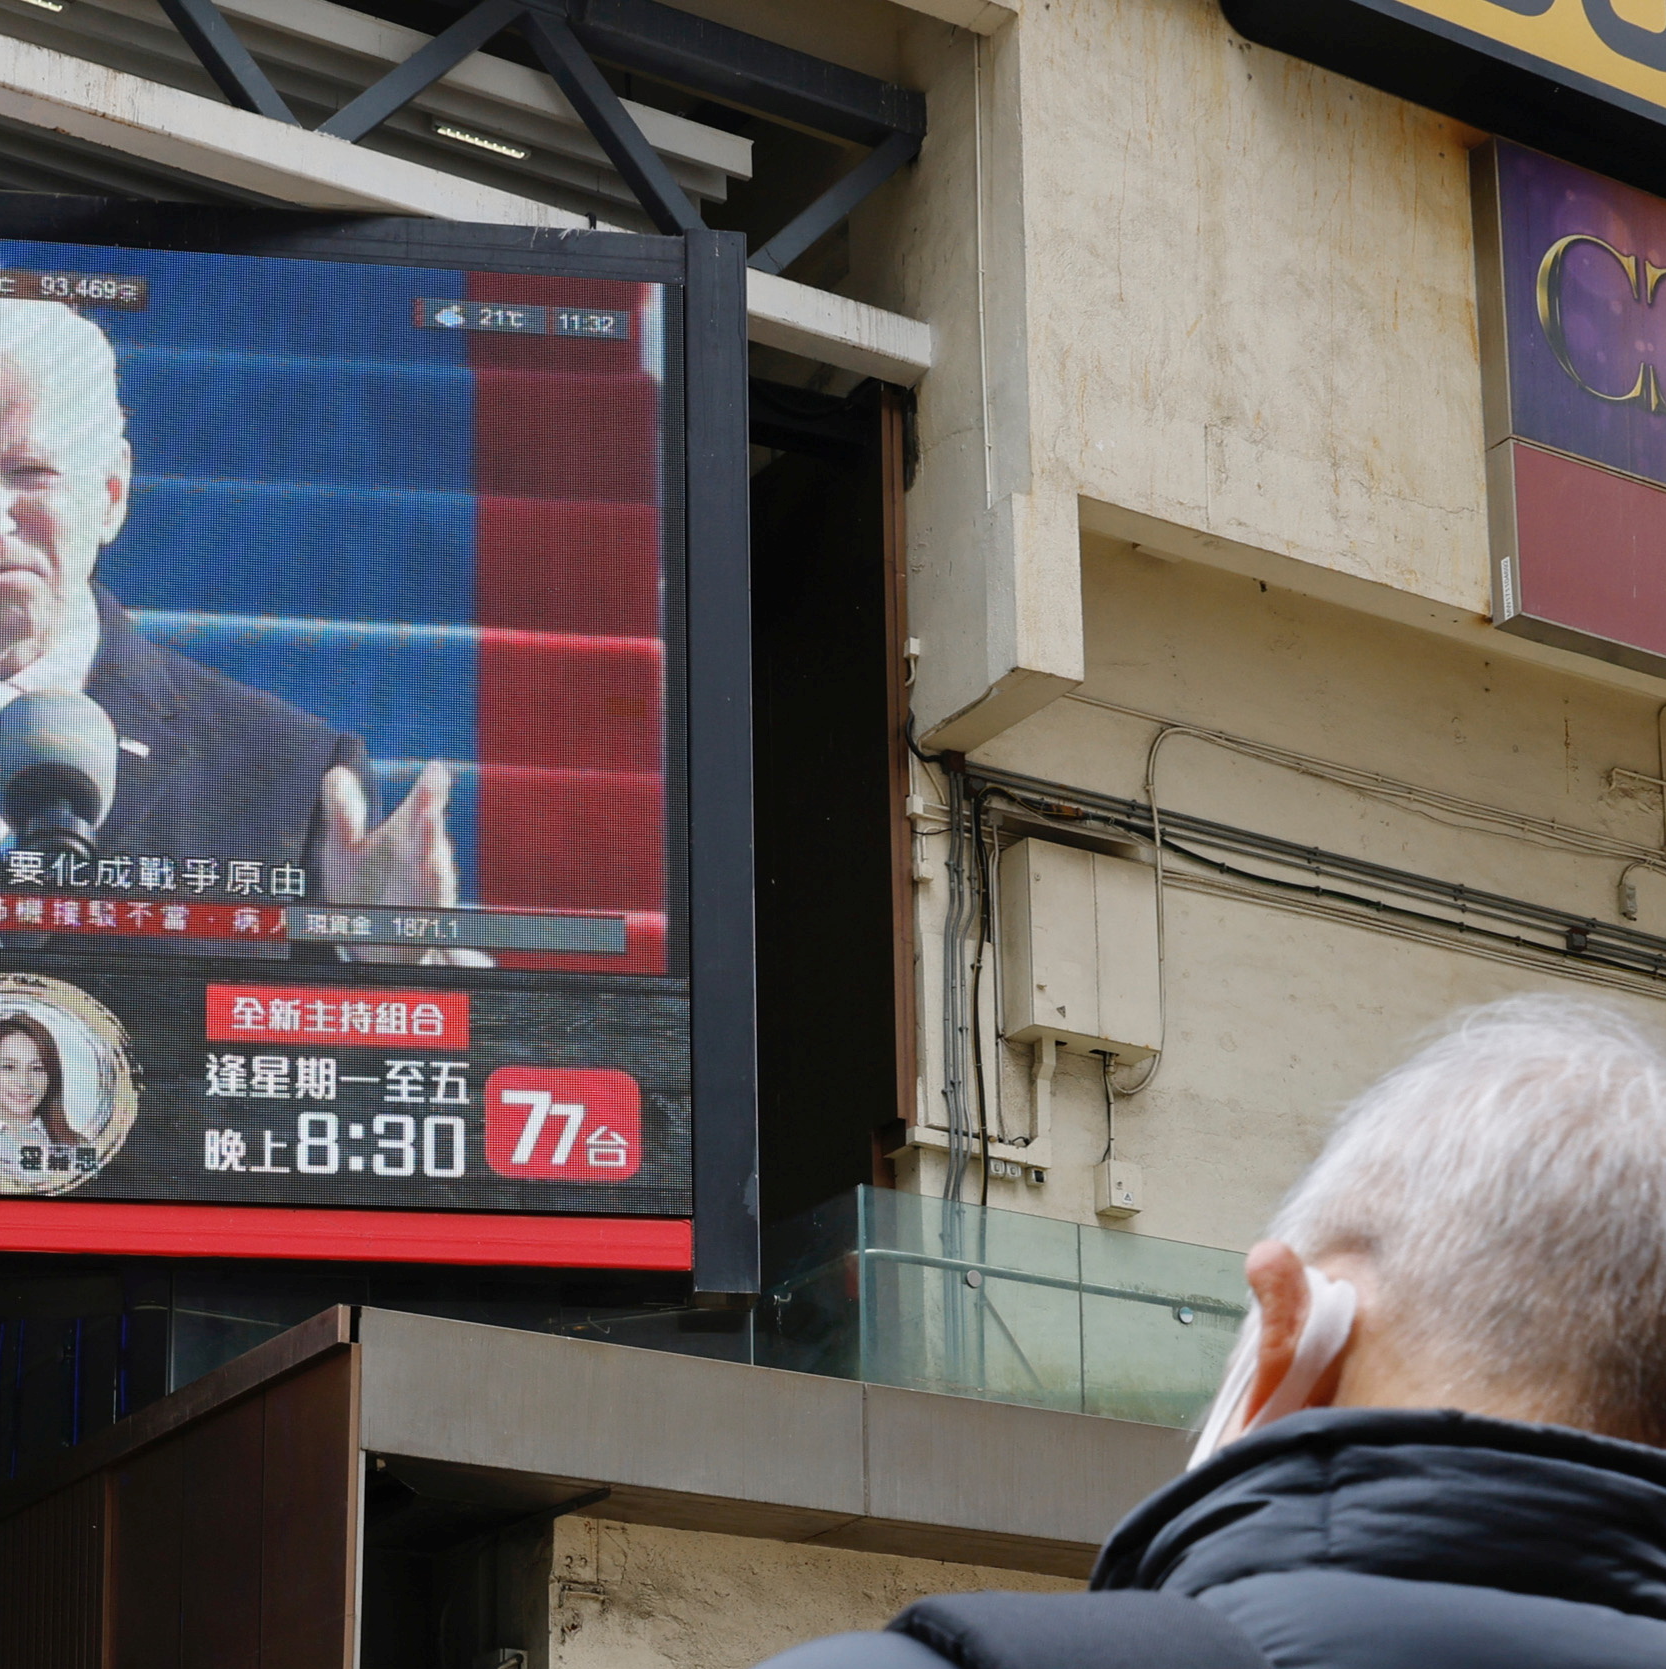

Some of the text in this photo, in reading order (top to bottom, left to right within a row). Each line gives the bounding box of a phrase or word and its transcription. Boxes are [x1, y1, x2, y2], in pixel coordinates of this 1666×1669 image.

[392, 915, 459, 939] 1871.1
[231, 995, 445, 1037] 全新主持組合
[205, 1053, 471, 1105] 逢星期一至五
